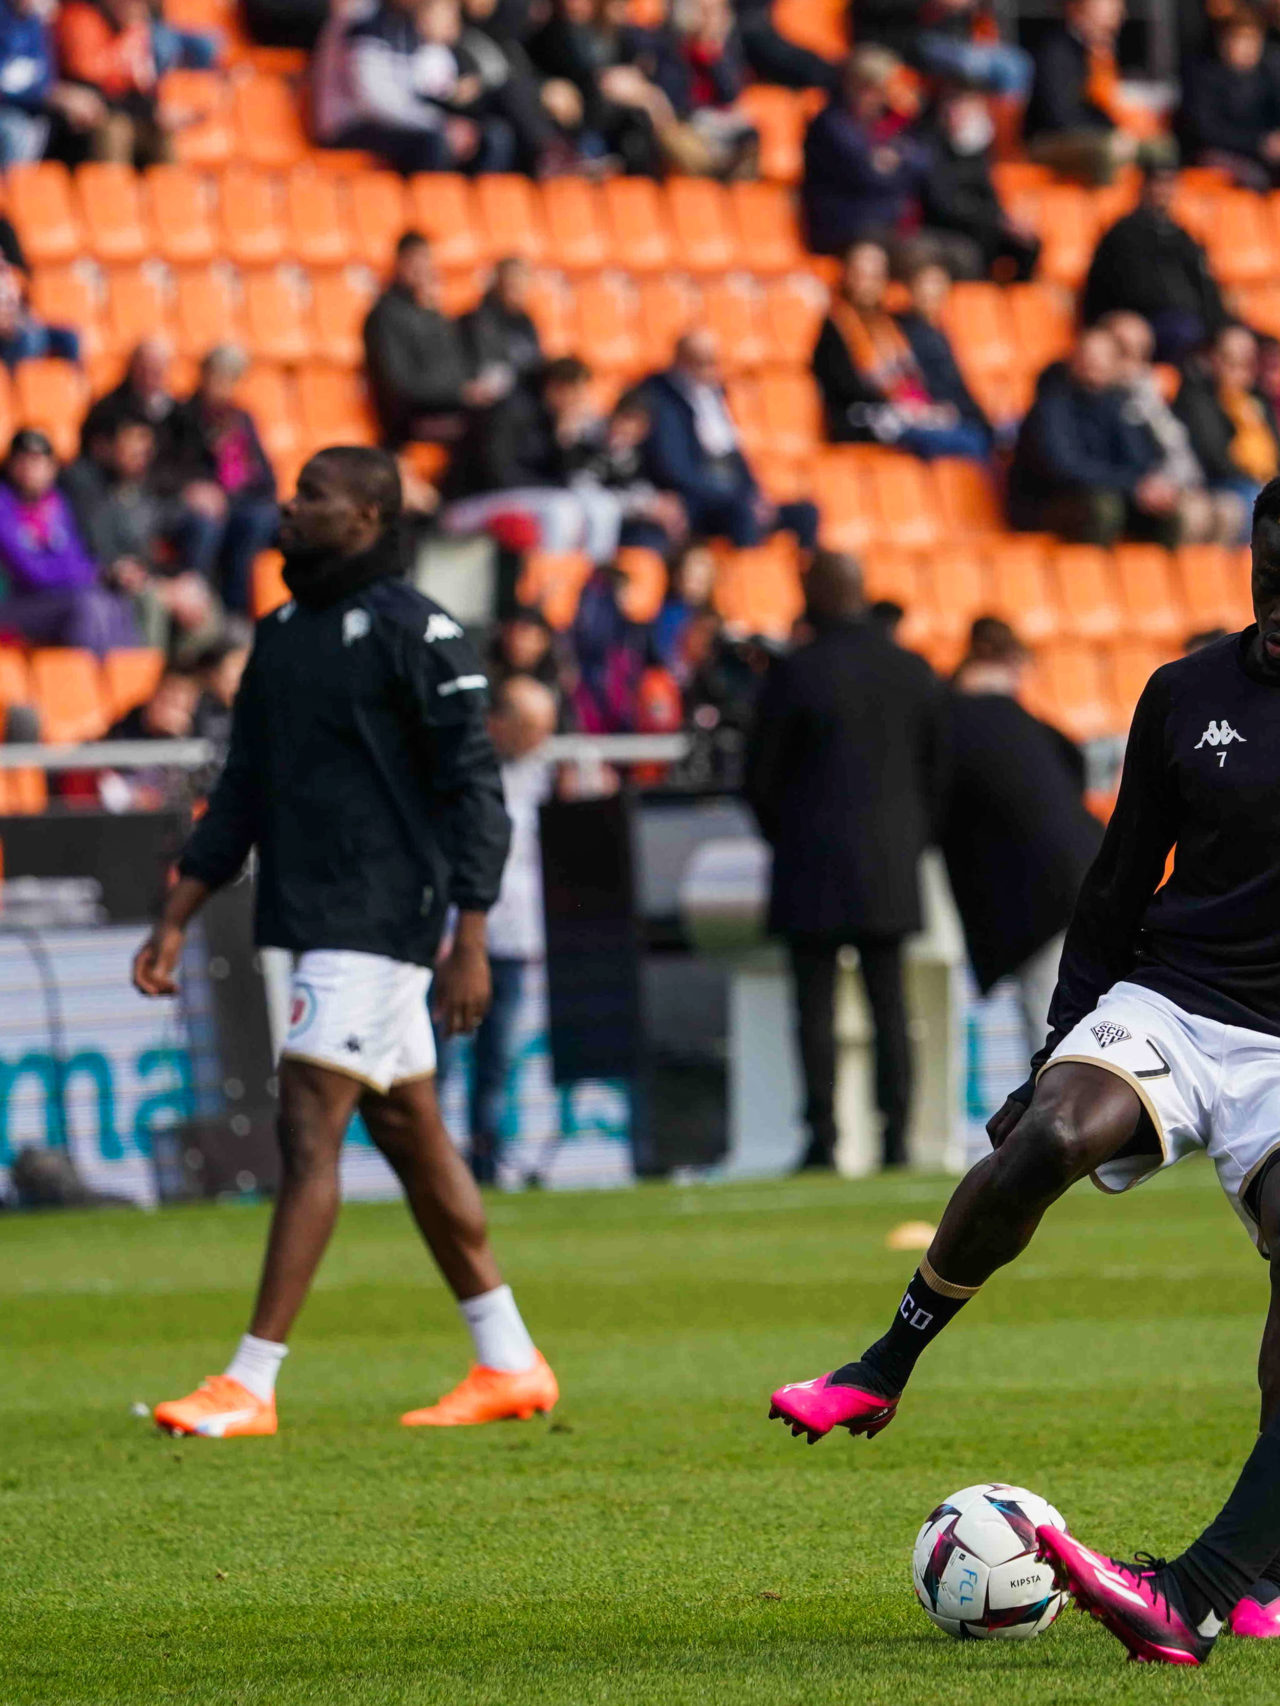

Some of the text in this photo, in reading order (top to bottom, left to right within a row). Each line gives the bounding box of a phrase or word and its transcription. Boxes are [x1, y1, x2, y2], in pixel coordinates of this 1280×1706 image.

[1216, 751, 1228, 768] 7
[1097, 1025, 1125, 1038] SCO
[900, 1277, 934, 1330] CO
[960, 1567, 978, 1606] FCL
[1010, 1574, 1042, 1588] KIPSTA
